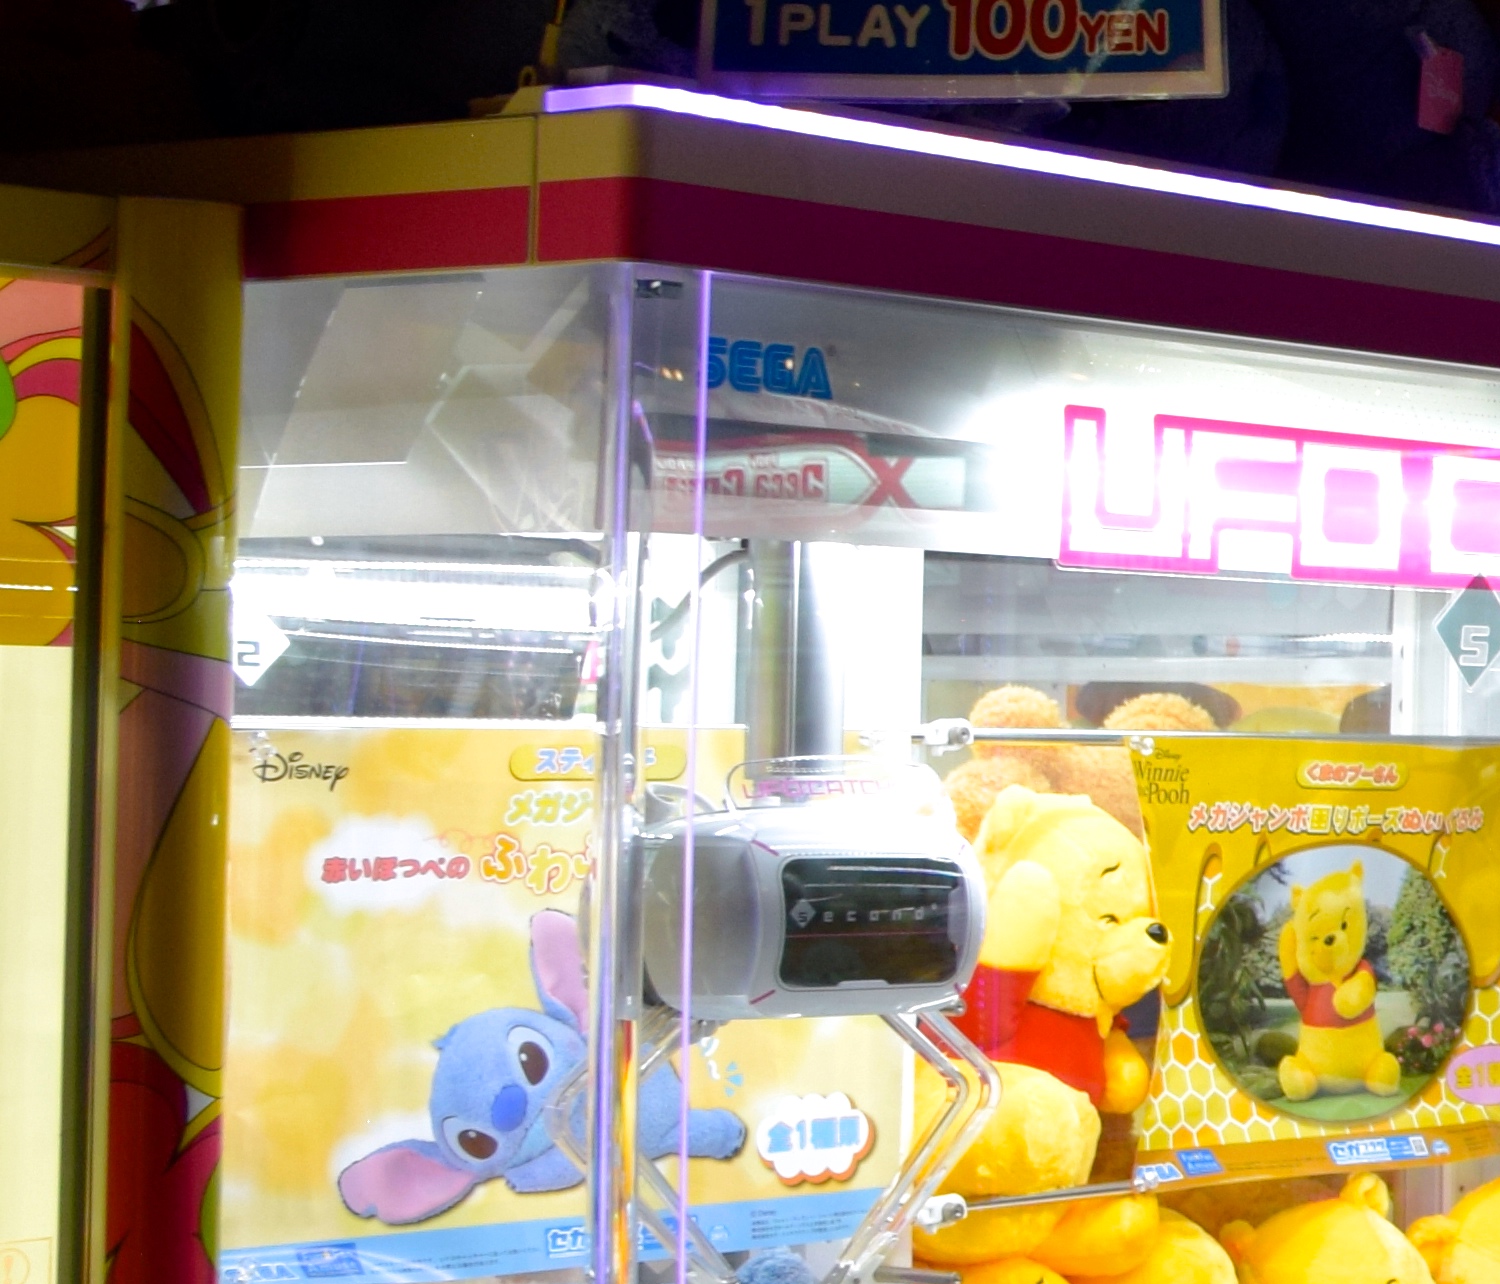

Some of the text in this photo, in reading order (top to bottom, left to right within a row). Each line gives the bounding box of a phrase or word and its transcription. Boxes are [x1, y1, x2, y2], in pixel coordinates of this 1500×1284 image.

[779, 4, 931, 48] PLAY
[944, 0, 1081, 60] 100
[1078, 9, 1168, 55] YEN
[702, 337, 833, 399] SEGA
[1062, 404, 1405, 585] UFO
[252, 752, 350, 791] Disney
[1131, 759, 1190, 783] Winnie
[1147, 781, 1190, 804] Pooh
